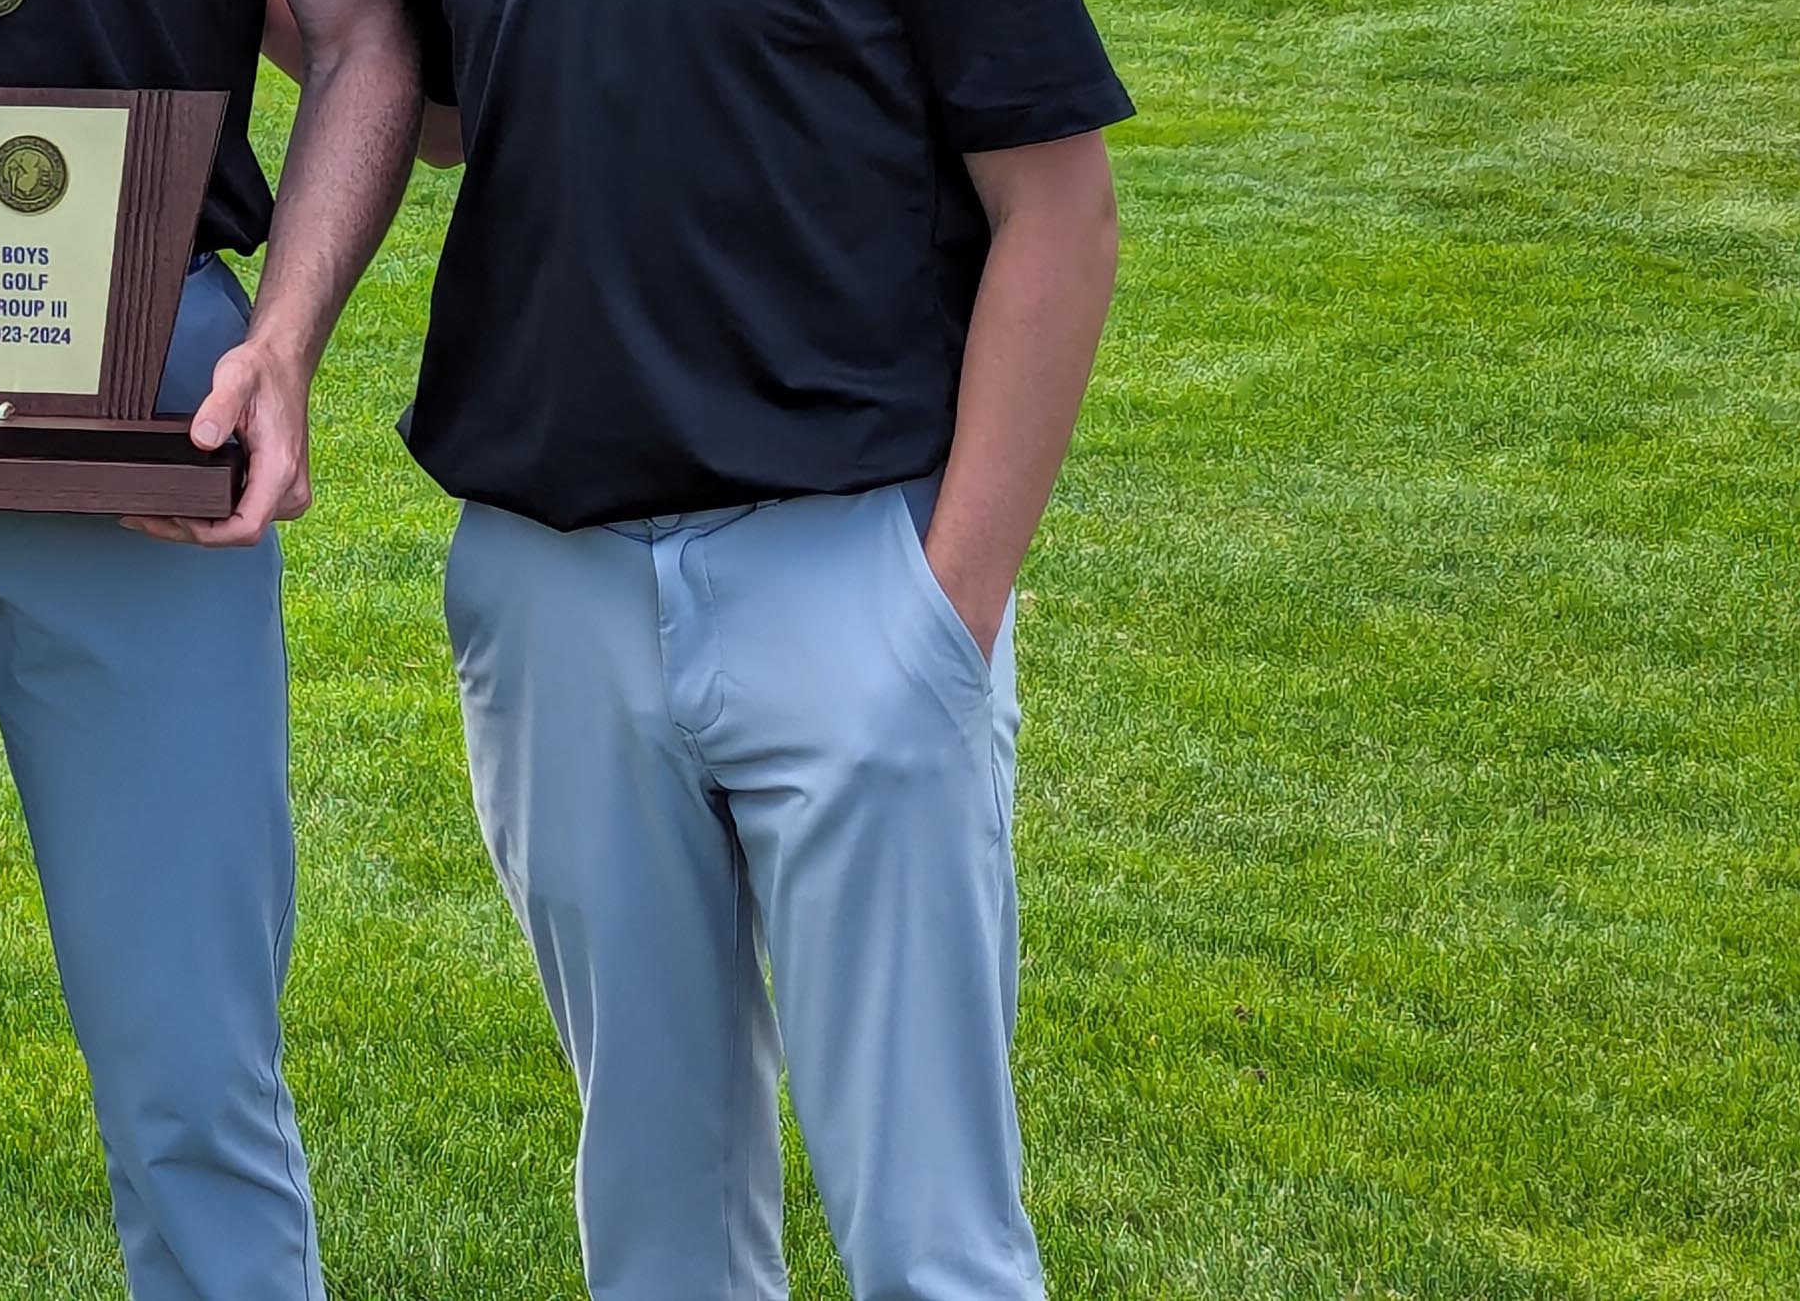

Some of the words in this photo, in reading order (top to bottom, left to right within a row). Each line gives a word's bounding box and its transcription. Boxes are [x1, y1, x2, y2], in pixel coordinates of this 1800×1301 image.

[1, 246, 49, 266] BOYS
[1, 272, 49, 291] GOLF
[50, 298, 68, 319] III
